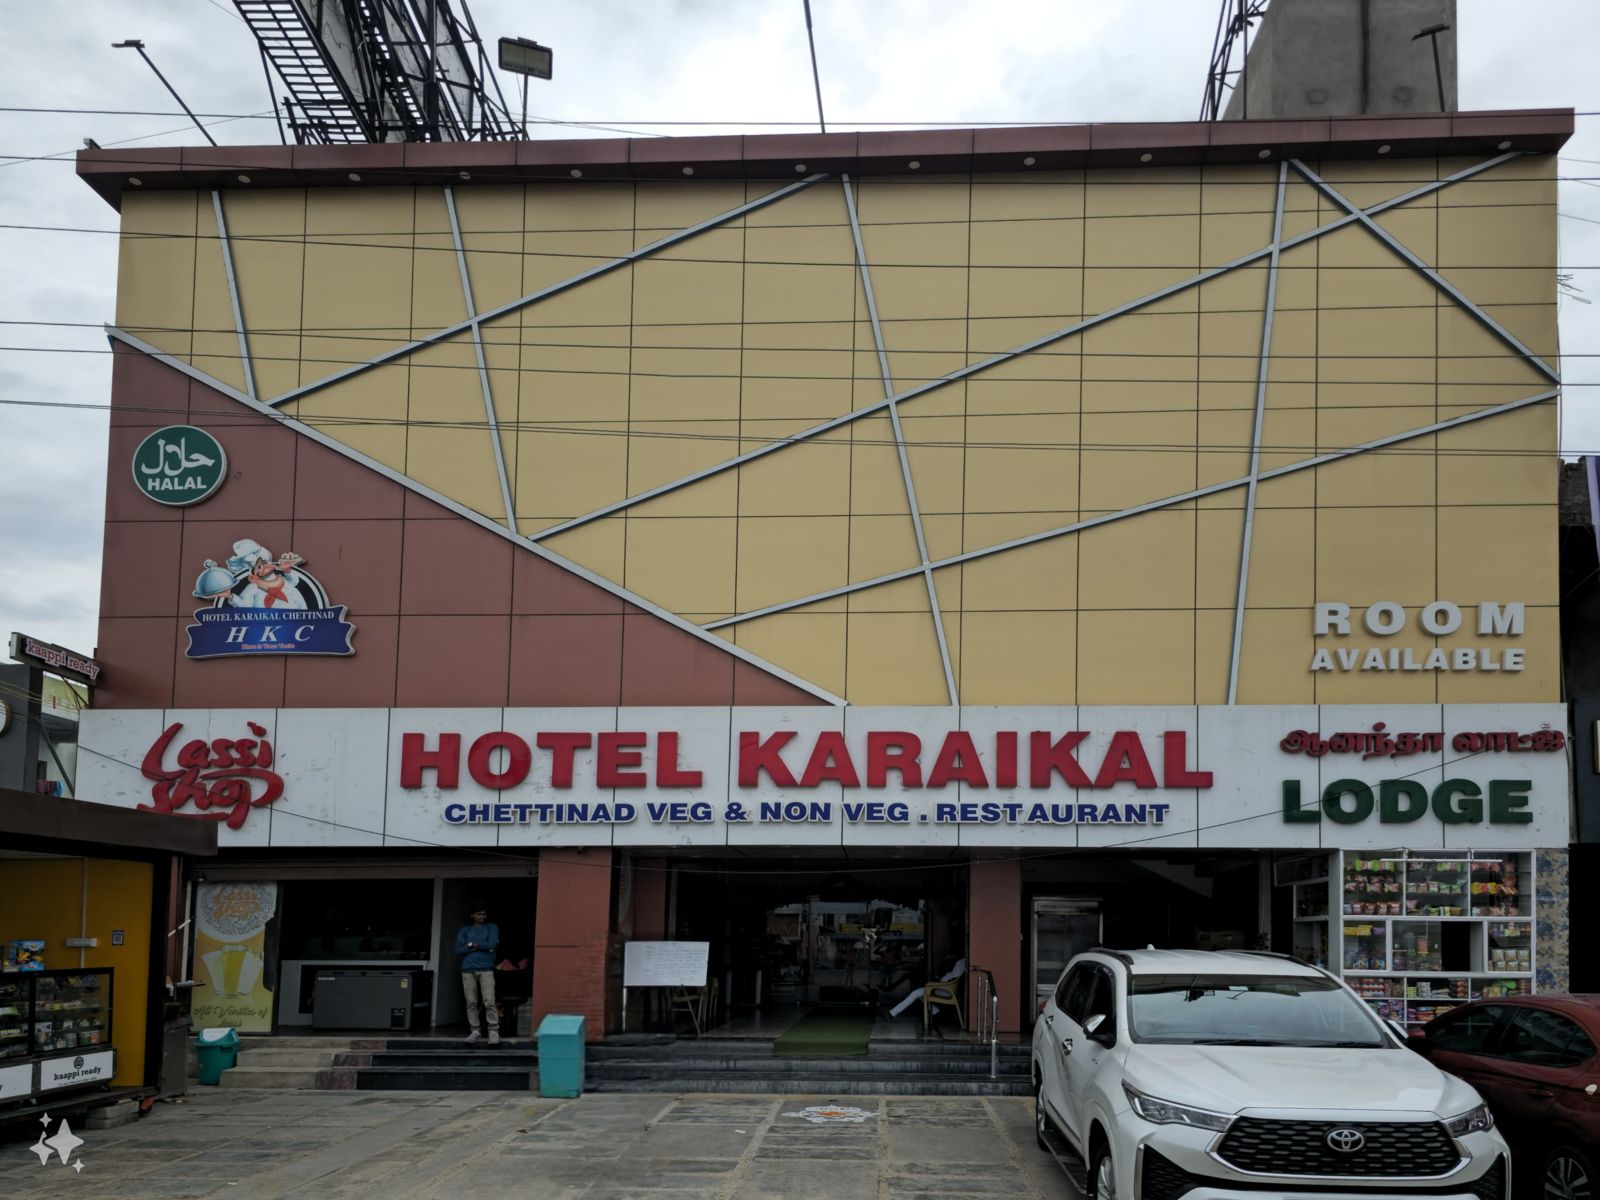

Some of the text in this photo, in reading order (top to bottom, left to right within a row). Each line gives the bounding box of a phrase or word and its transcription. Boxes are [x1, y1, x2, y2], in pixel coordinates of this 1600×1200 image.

[141, 436, 216, 476] حلال
[147, 476, 207, 491] HALAL
[202, 611, 335, 622] HOTEL KARAIKAL CHETTINAD
[1313, 600, 1525, 636] ROOM
[25, 638, 100, 680] kaappi ready
[1310, 648, 1526, 673] AVAILABLE
[141, 722, 273, 782] Lassi
[1280, 721, 1446, 761] ஆனந்தா
[400, 731, 1213, 790] HOTEL KARAIKAL
[443, 802, 636, 826] CHETTINAD
[646, 802, 716, 824] VEG
[723, 802, 752, 824] &
[760, 801, 833, 824] NON
[1282, 778, 1534, 825] LODGE
[54, 1066, 102, 1081] kaappi ready
